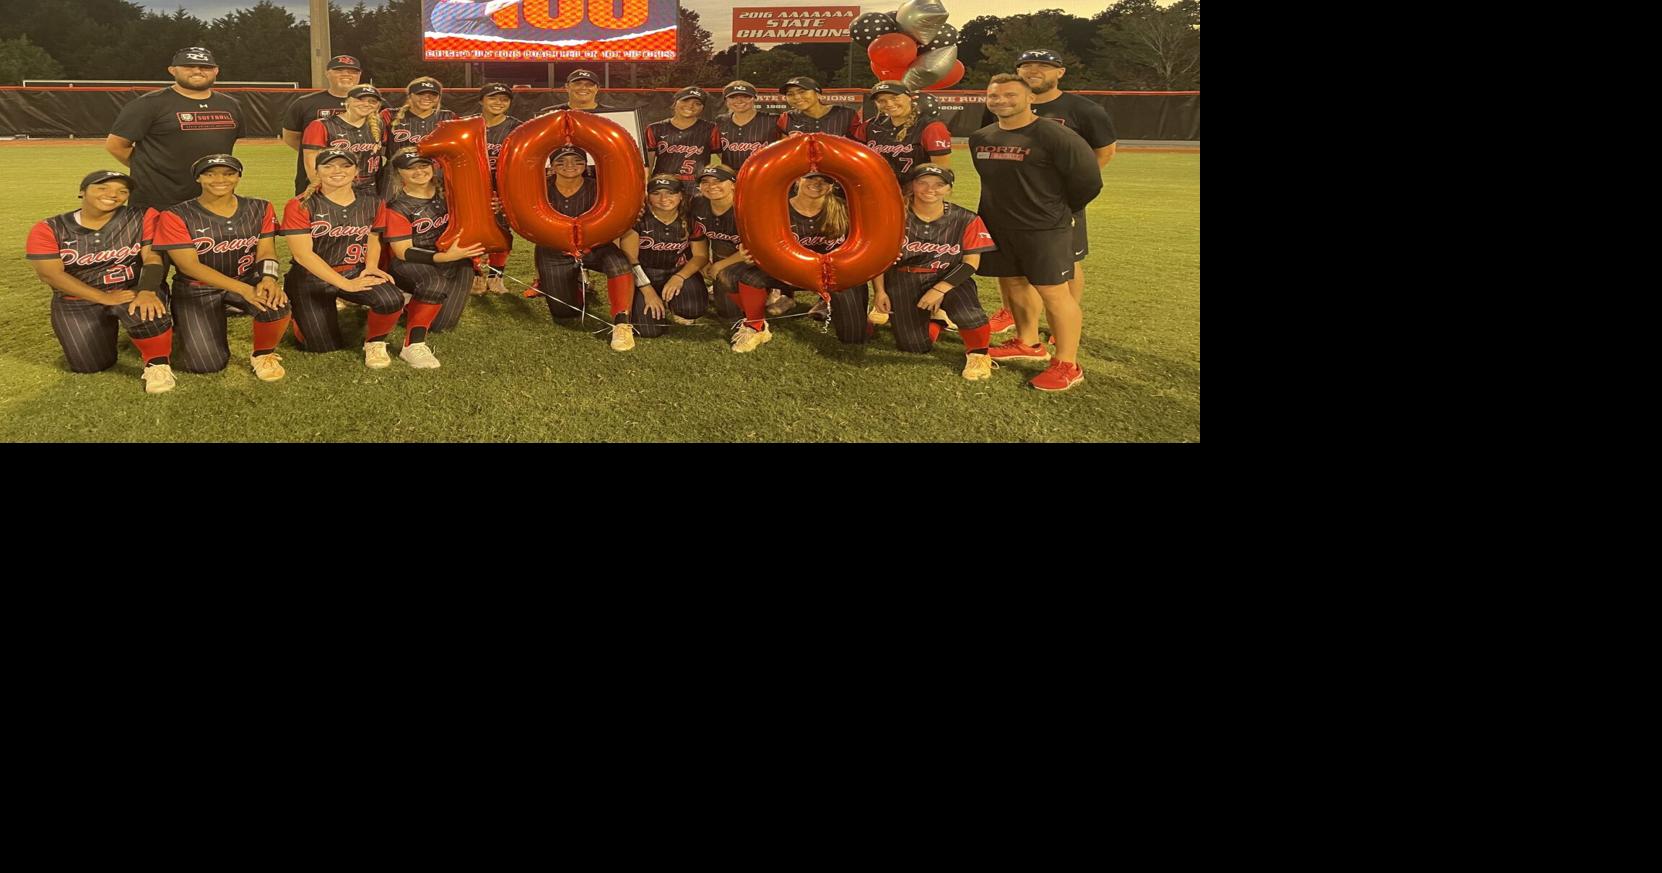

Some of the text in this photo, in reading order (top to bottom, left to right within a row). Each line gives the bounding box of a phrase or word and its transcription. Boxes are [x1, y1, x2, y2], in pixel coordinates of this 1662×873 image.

[765, 19, 826, 28] STATE
[736, 29, 851, 38] CHAMPIONS
[658, 140, 704, 158] Dawgs
[680, 159, 697, 175] 5
[899, 157, 913, 173] 7
[310, 220, 372, 241] Dawg
[59, 242, 141, 265] Dawgs
[191, 235, 260, 255] Dawg
[103, 263, 135, 285] 21
